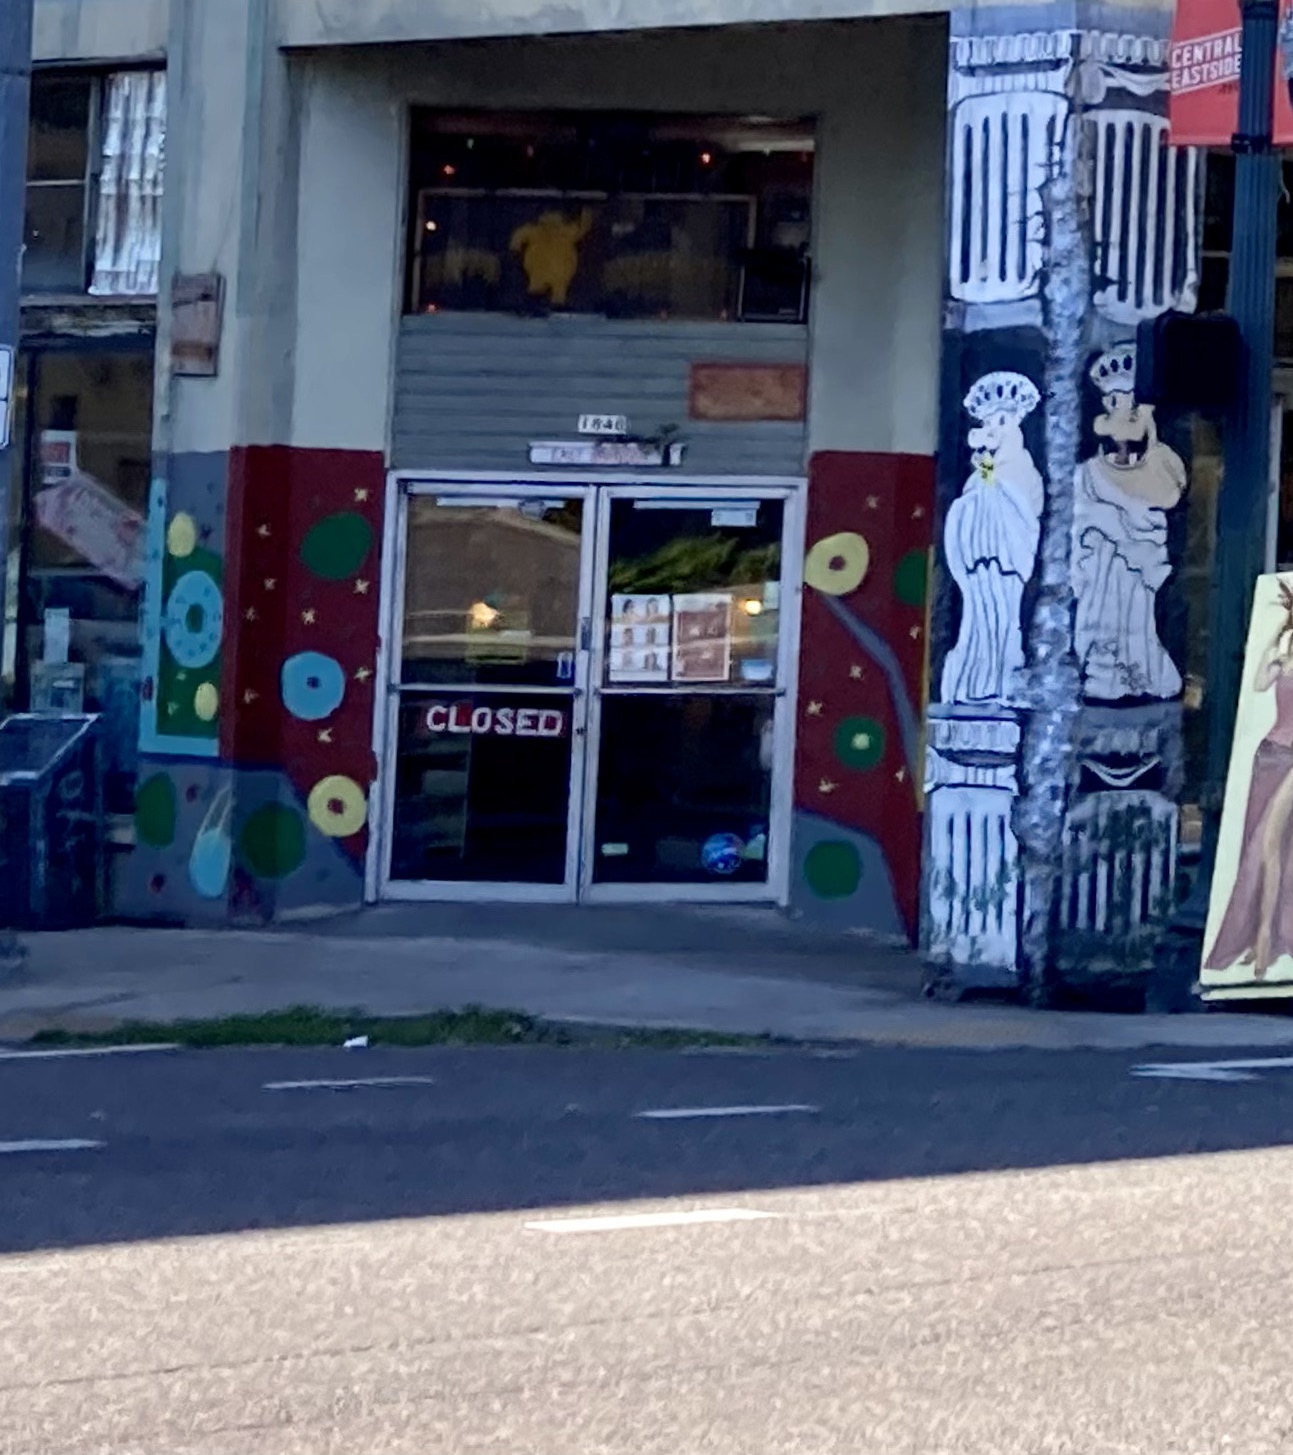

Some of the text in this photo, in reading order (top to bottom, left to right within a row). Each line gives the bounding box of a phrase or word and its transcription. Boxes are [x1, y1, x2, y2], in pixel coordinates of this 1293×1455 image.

[1171, 32, 1243, 68] CENTRAL
[1171, 54, 1242, 89] EASTSIDE
[426, 704, 565, 737] CLOSED
